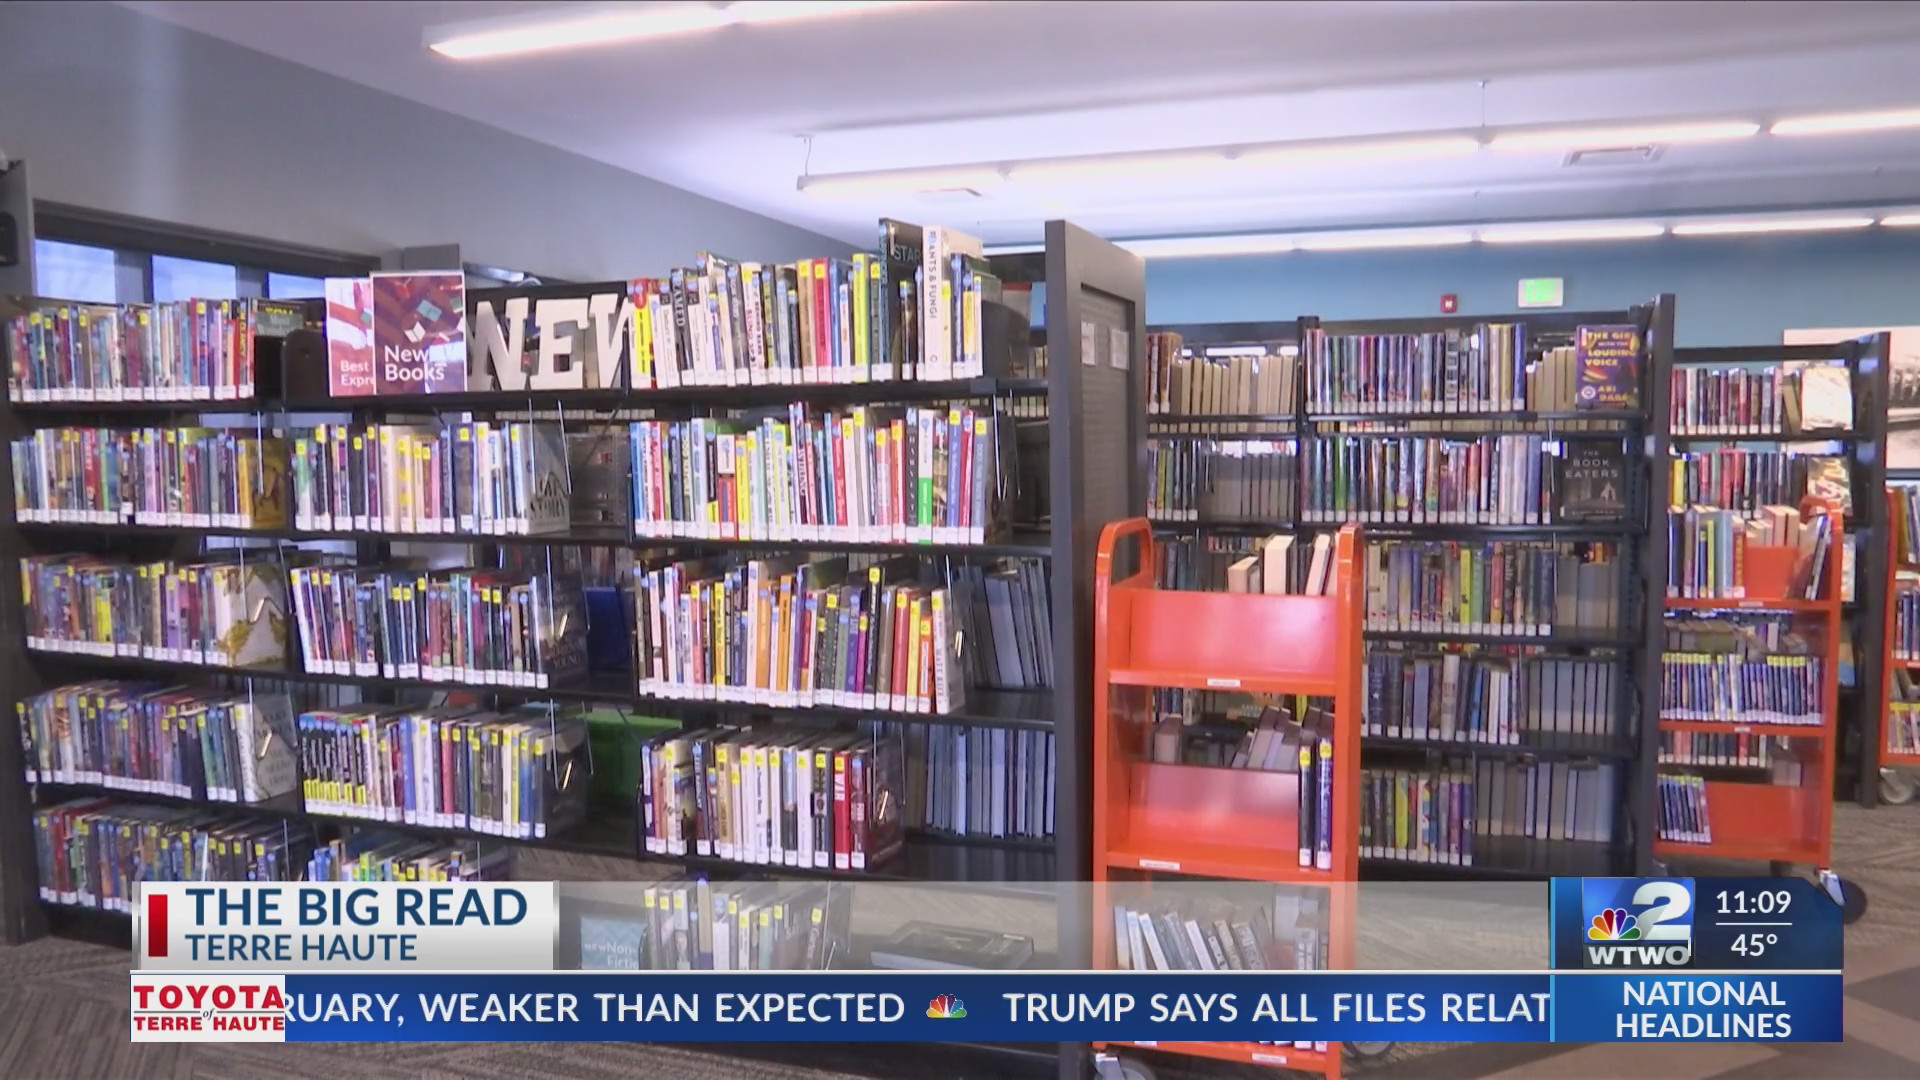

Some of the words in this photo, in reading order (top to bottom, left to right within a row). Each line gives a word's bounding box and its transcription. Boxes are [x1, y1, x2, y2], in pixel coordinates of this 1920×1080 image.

[928, 231, 937, 272] PANTS
[928, 286, 937, 319] FUNGI
[467, 293, 638, 391] NEW
[384, 345, 429, 363] New
[340, 360, 369, 372] Best
[384, 363, 445, 382] Books
[1572, 458, 1609, 467] BOOK
[1565, 469, 1618, 478] EATERS
